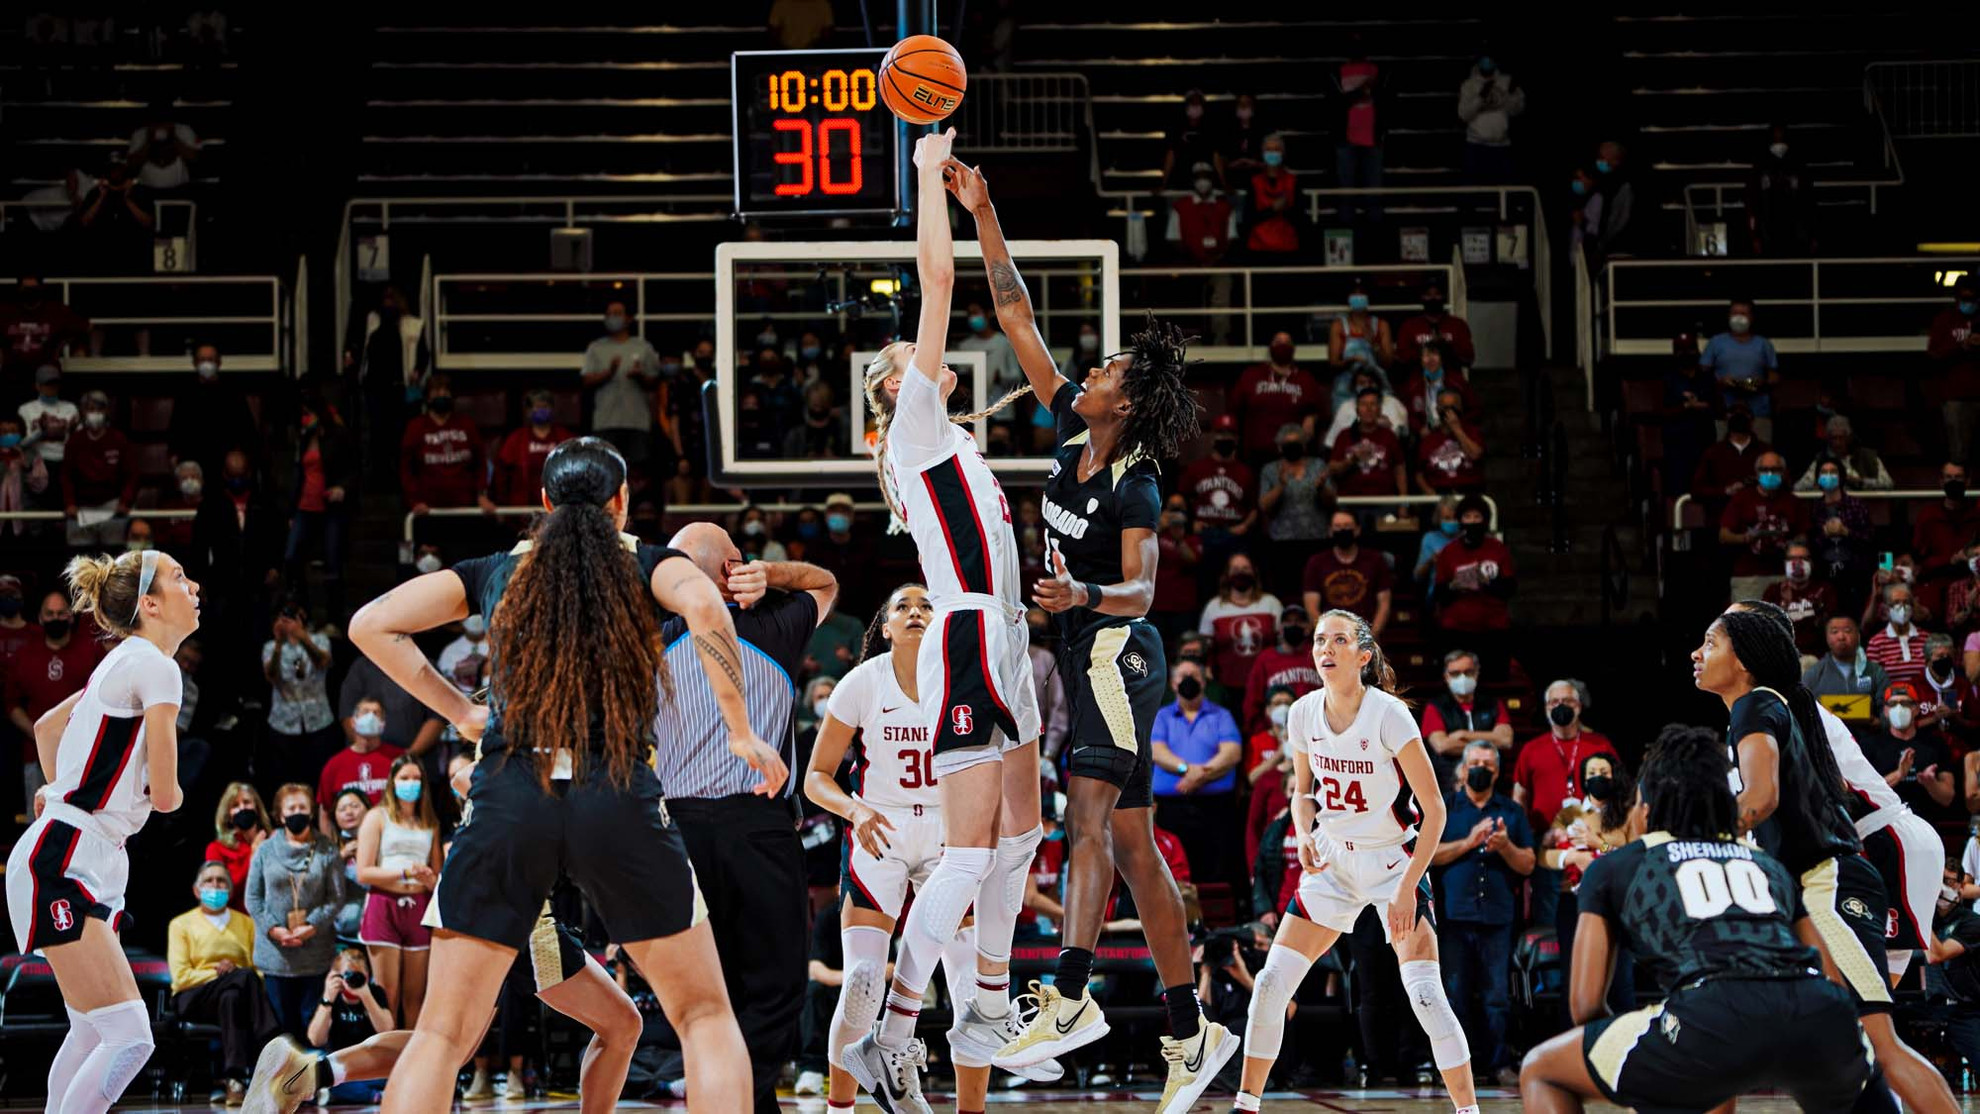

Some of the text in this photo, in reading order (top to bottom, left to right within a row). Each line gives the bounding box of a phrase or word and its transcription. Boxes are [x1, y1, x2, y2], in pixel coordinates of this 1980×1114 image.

[769, 68, 877, 112] 10:00
[912, 85, 958, 111] ELITE
[773, 118, 862, 195] 30
[164, 248, 176, 270] 8
[1705, 234, 1718, 254] 6
[1041, 491, 1089, 539] LORADO
[883, 726, 929, 742] STANF
[1314, 753, 1374, 775] STANFORD
[1322, 776, 1368, 813] 24
[1675, 857, 1777, 919] 00
